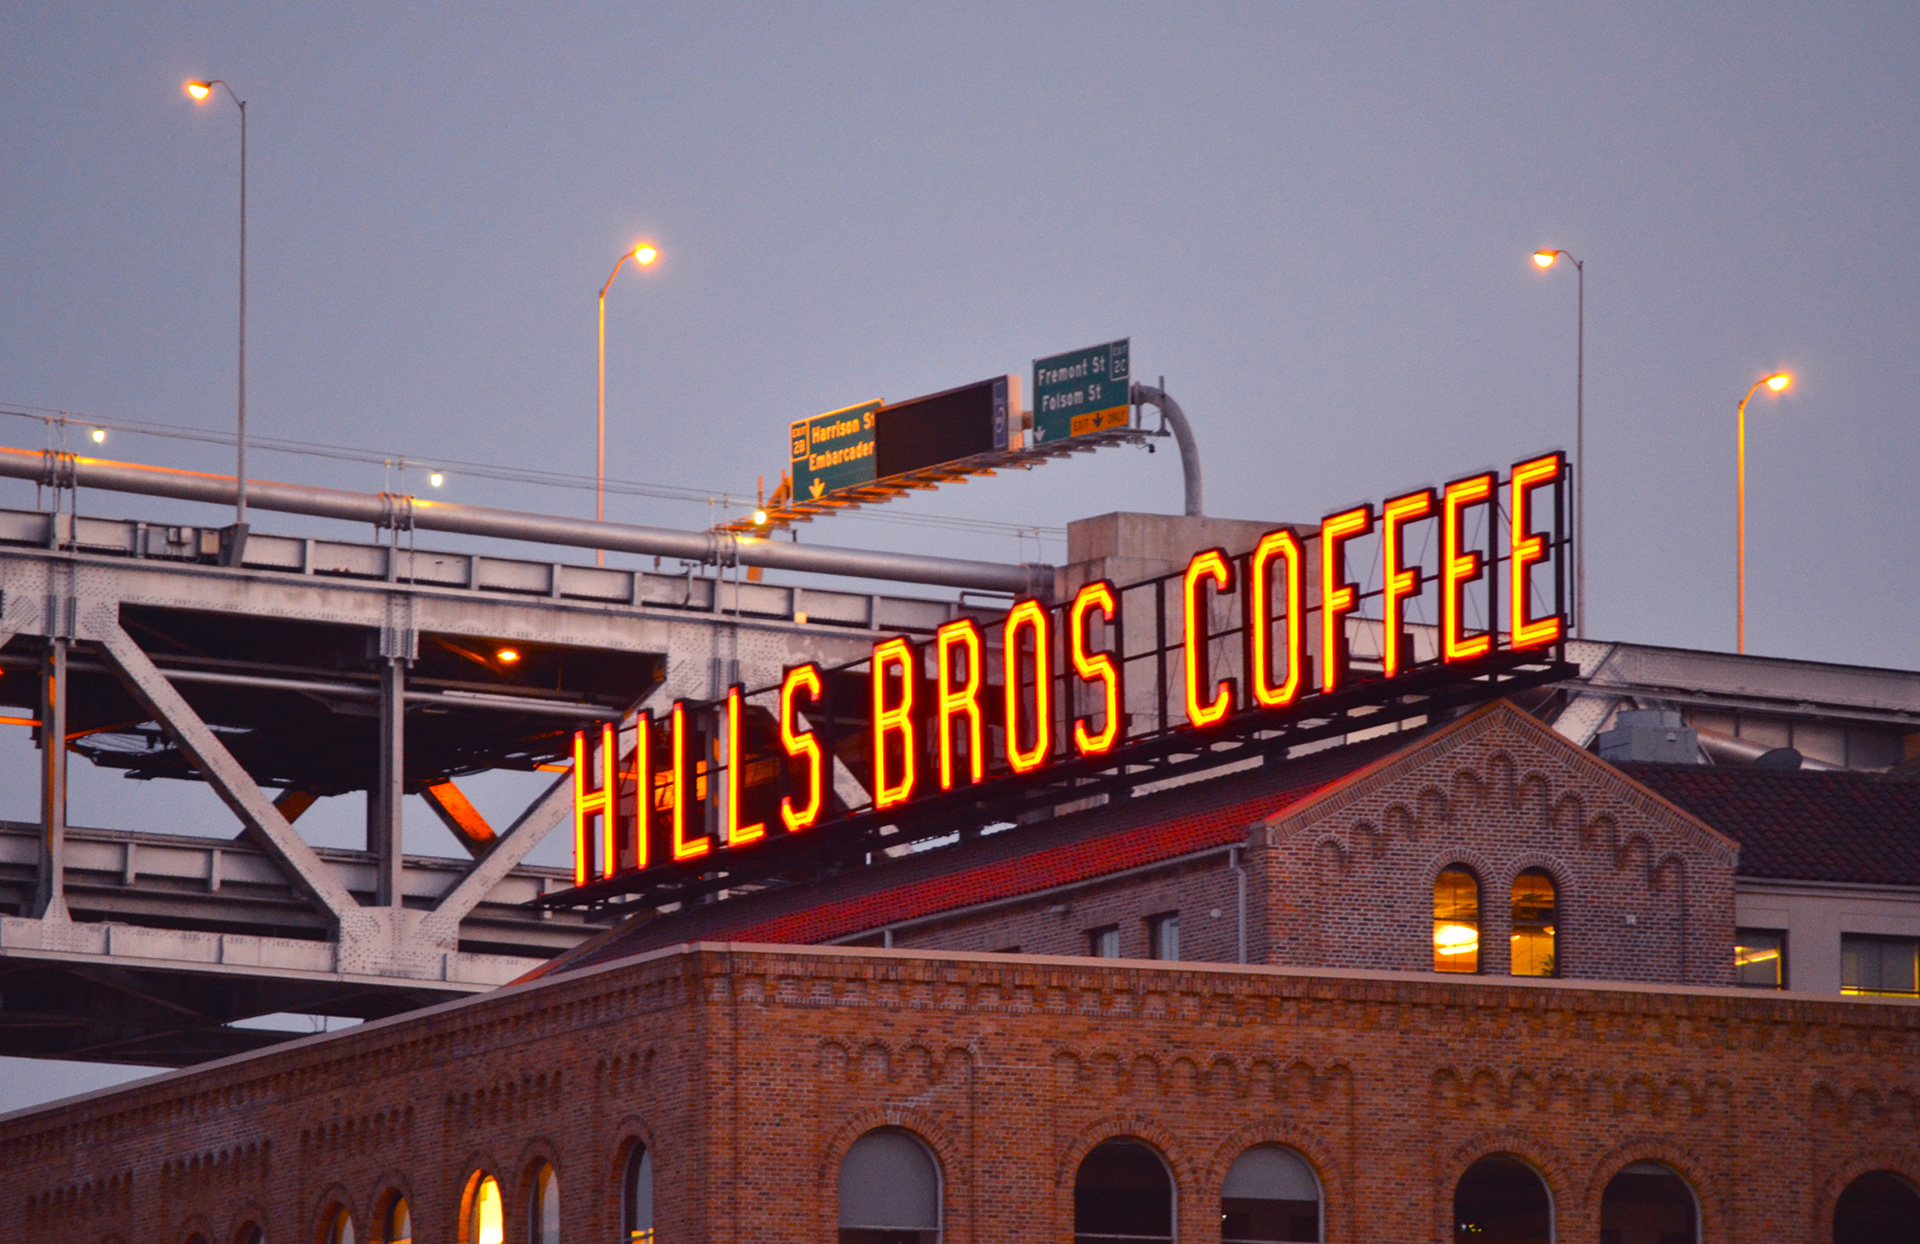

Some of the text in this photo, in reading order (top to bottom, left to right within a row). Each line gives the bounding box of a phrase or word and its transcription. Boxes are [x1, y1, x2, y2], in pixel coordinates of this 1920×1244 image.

[1038, 355, 1105, 386] Fremont St
[1114, 359, 1126, 373] 2C
[1042, 383, 1102, 412] Folsom St
[812, 418, 860, 444] Harrison
[574, 454, 1561, 887] HILLS BROS COFFEE
